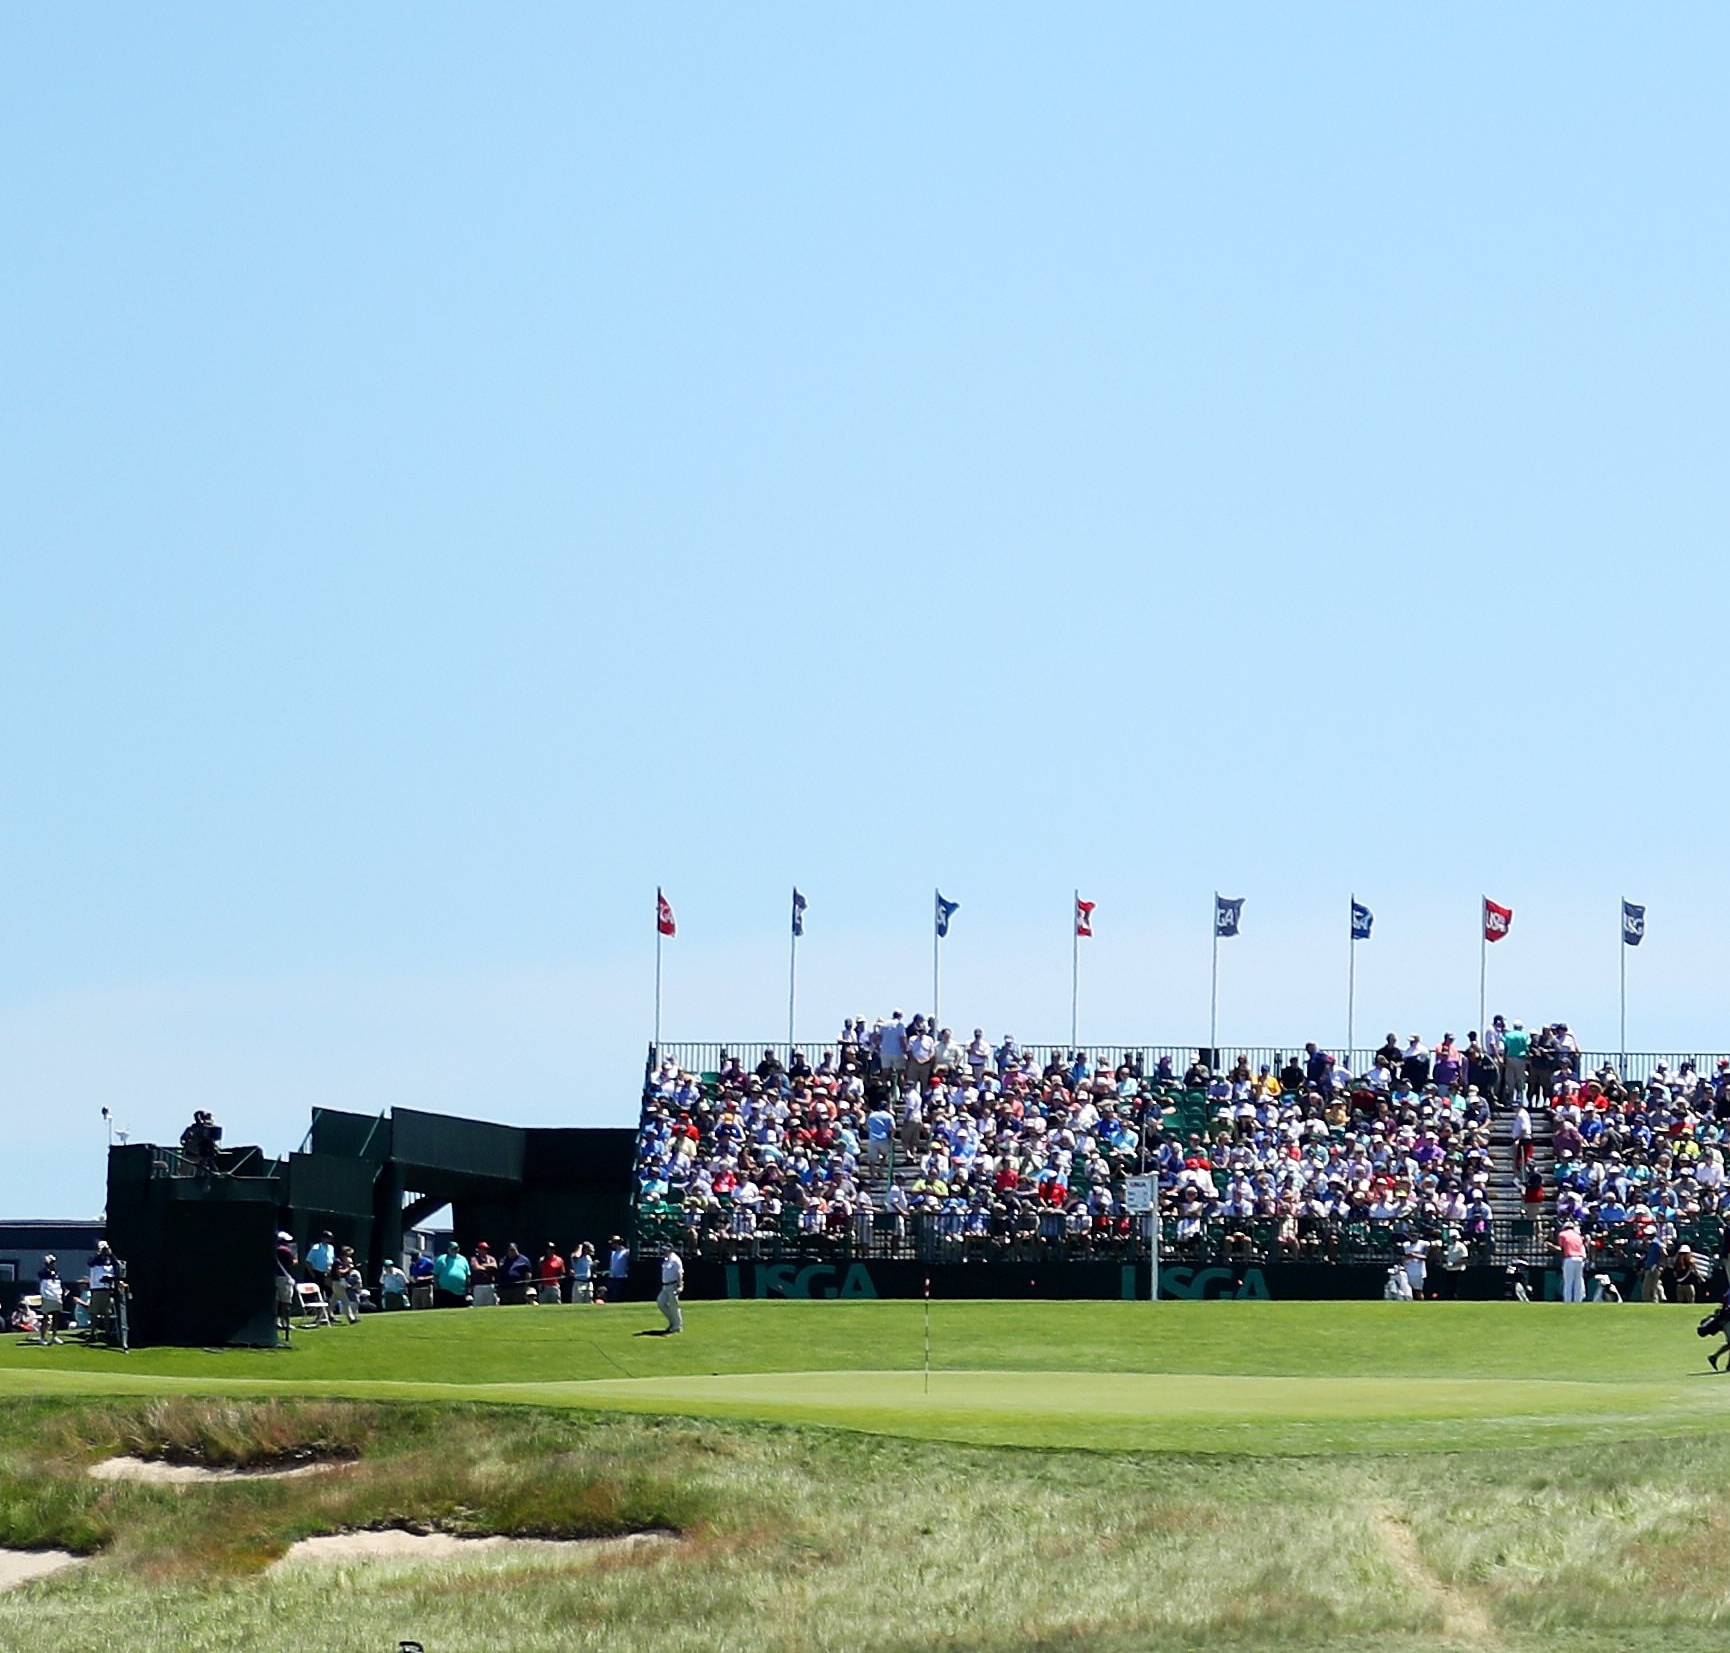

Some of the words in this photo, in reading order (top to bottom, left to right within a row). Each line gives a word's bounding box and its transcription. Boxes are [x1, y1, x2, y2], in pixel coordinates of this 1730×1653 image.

[1217, 908, 1234, 926] GA
[1624, 912, 1643, 936] USG
[725, 1263, 879, 1300] USGA
[1122, 1265, 1272, 1300] USGA
